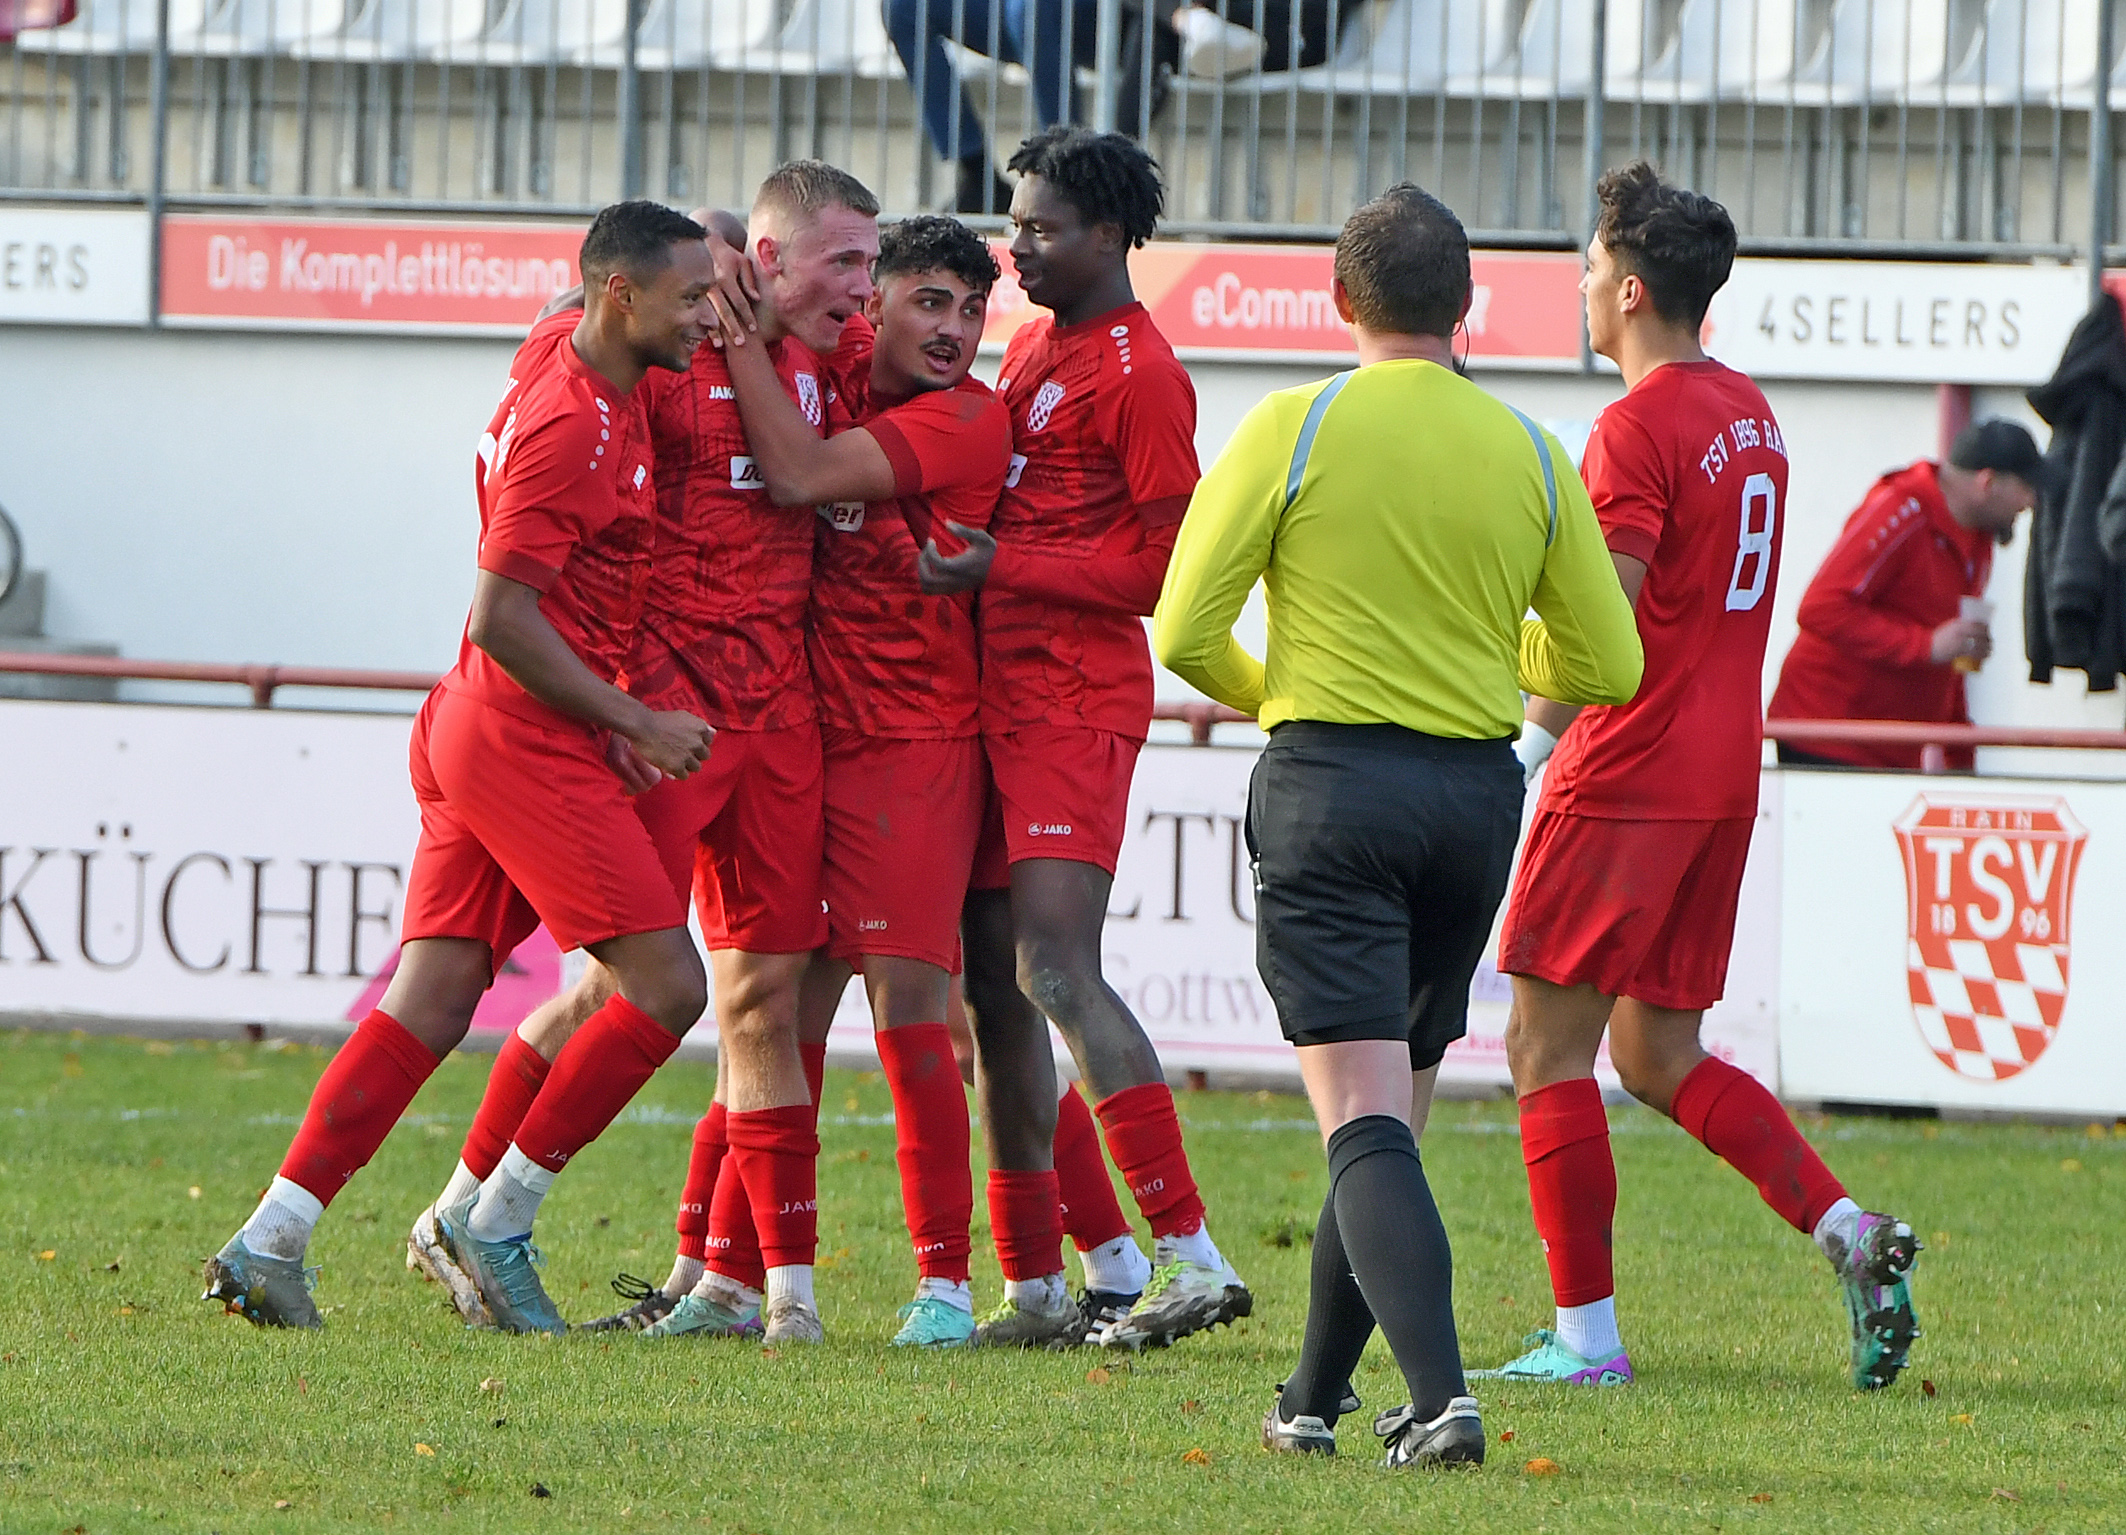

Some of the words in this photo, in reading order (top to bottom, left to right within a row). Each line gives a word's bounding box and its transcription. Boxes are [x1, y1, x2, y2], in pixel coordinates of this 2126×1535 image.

[208, 234, 270, 291] Die
[1757, 293, 2021, 350] 4SELLERS
[709, 385, 736, 400] JAK
[1700, 432, 1729, 484] TSV
[1729, 417, 1761, 452] 1896
[1725, 472, 1776, 612] 8
[1042, 824, 1072, 835] JAKO
[1950, 807, 2032, 830] RAIN
[1925, 836, 2058, 941] TSV
[865, 919, 888, 930] JAKO
[1931, 902, 1957, 936] 18
[2020, 906, 2051, 939] 96
